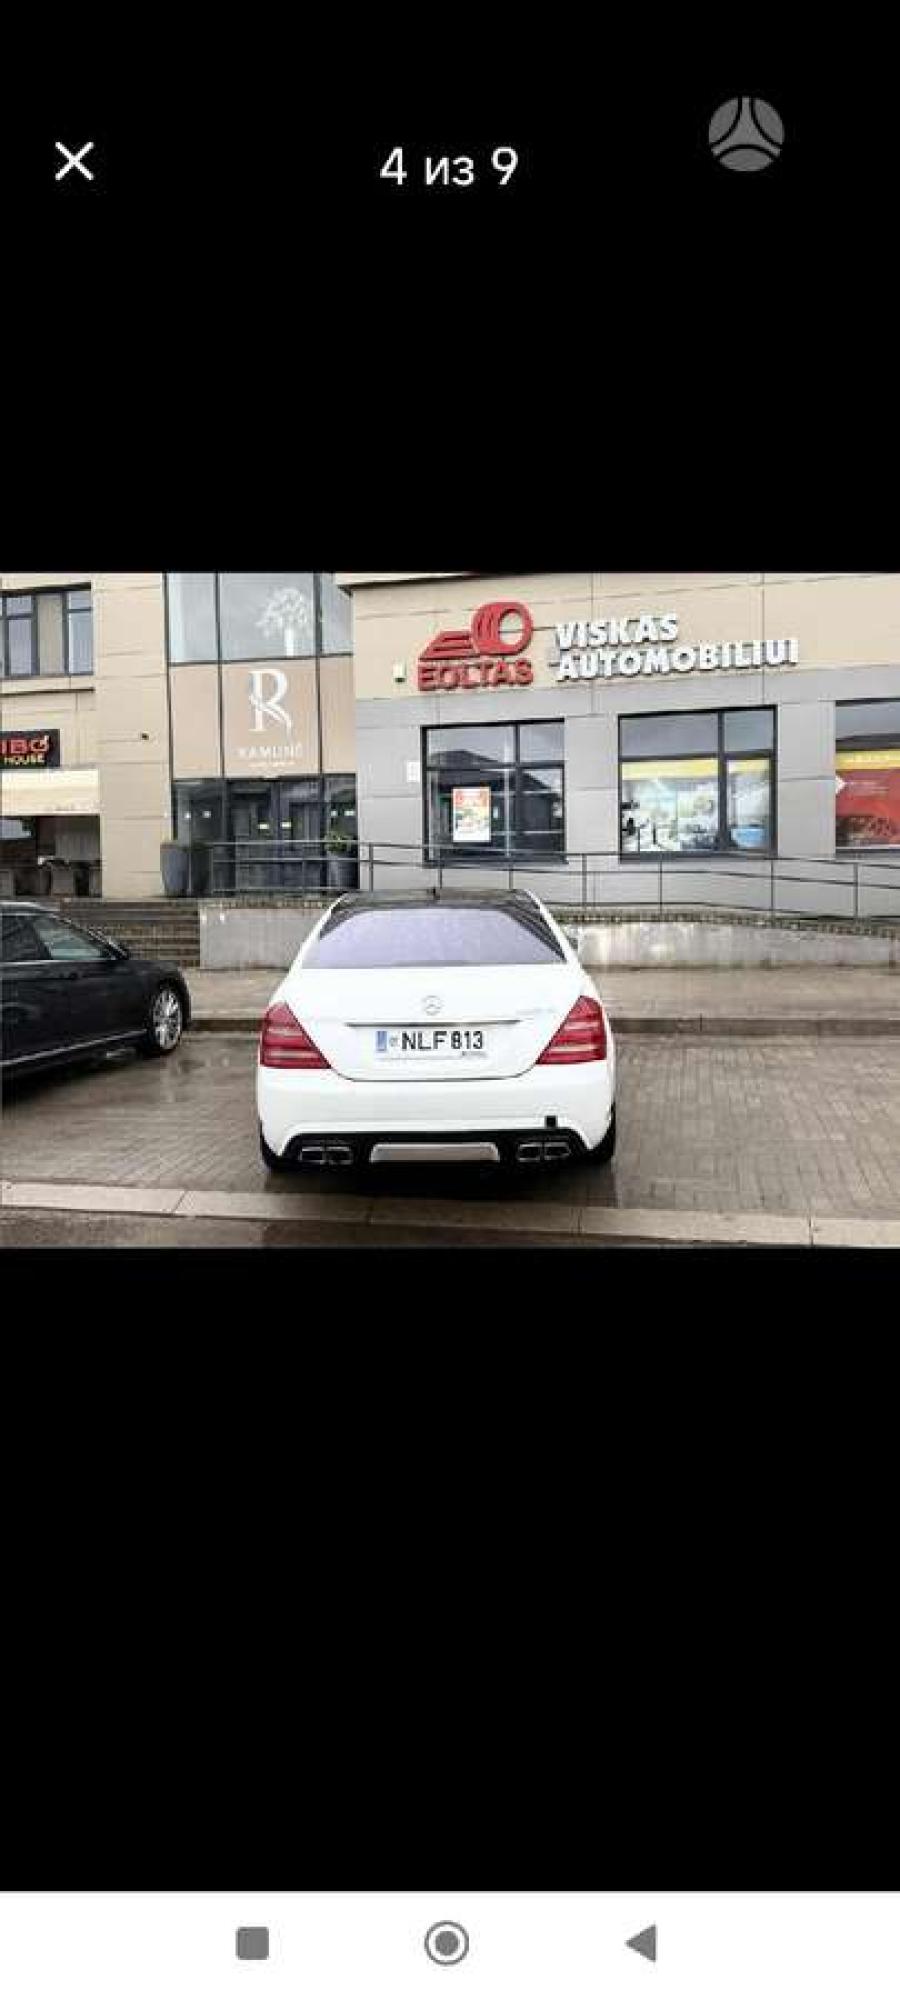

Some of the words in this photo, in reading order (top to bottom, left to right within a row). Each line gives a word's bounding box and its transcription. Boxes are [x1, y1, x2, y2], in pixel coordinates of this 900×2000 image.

[556, 613, 678, 650] VISKAS
[417, 659, 533, 690] EOLTAS
[558, 639, 799, 681] AUTOMOBILIUI
[3, 753, 46, 766] HOUSE
[401, 1031, 447, 1050] NLF
[450, 1030, 483, 1050] 813
